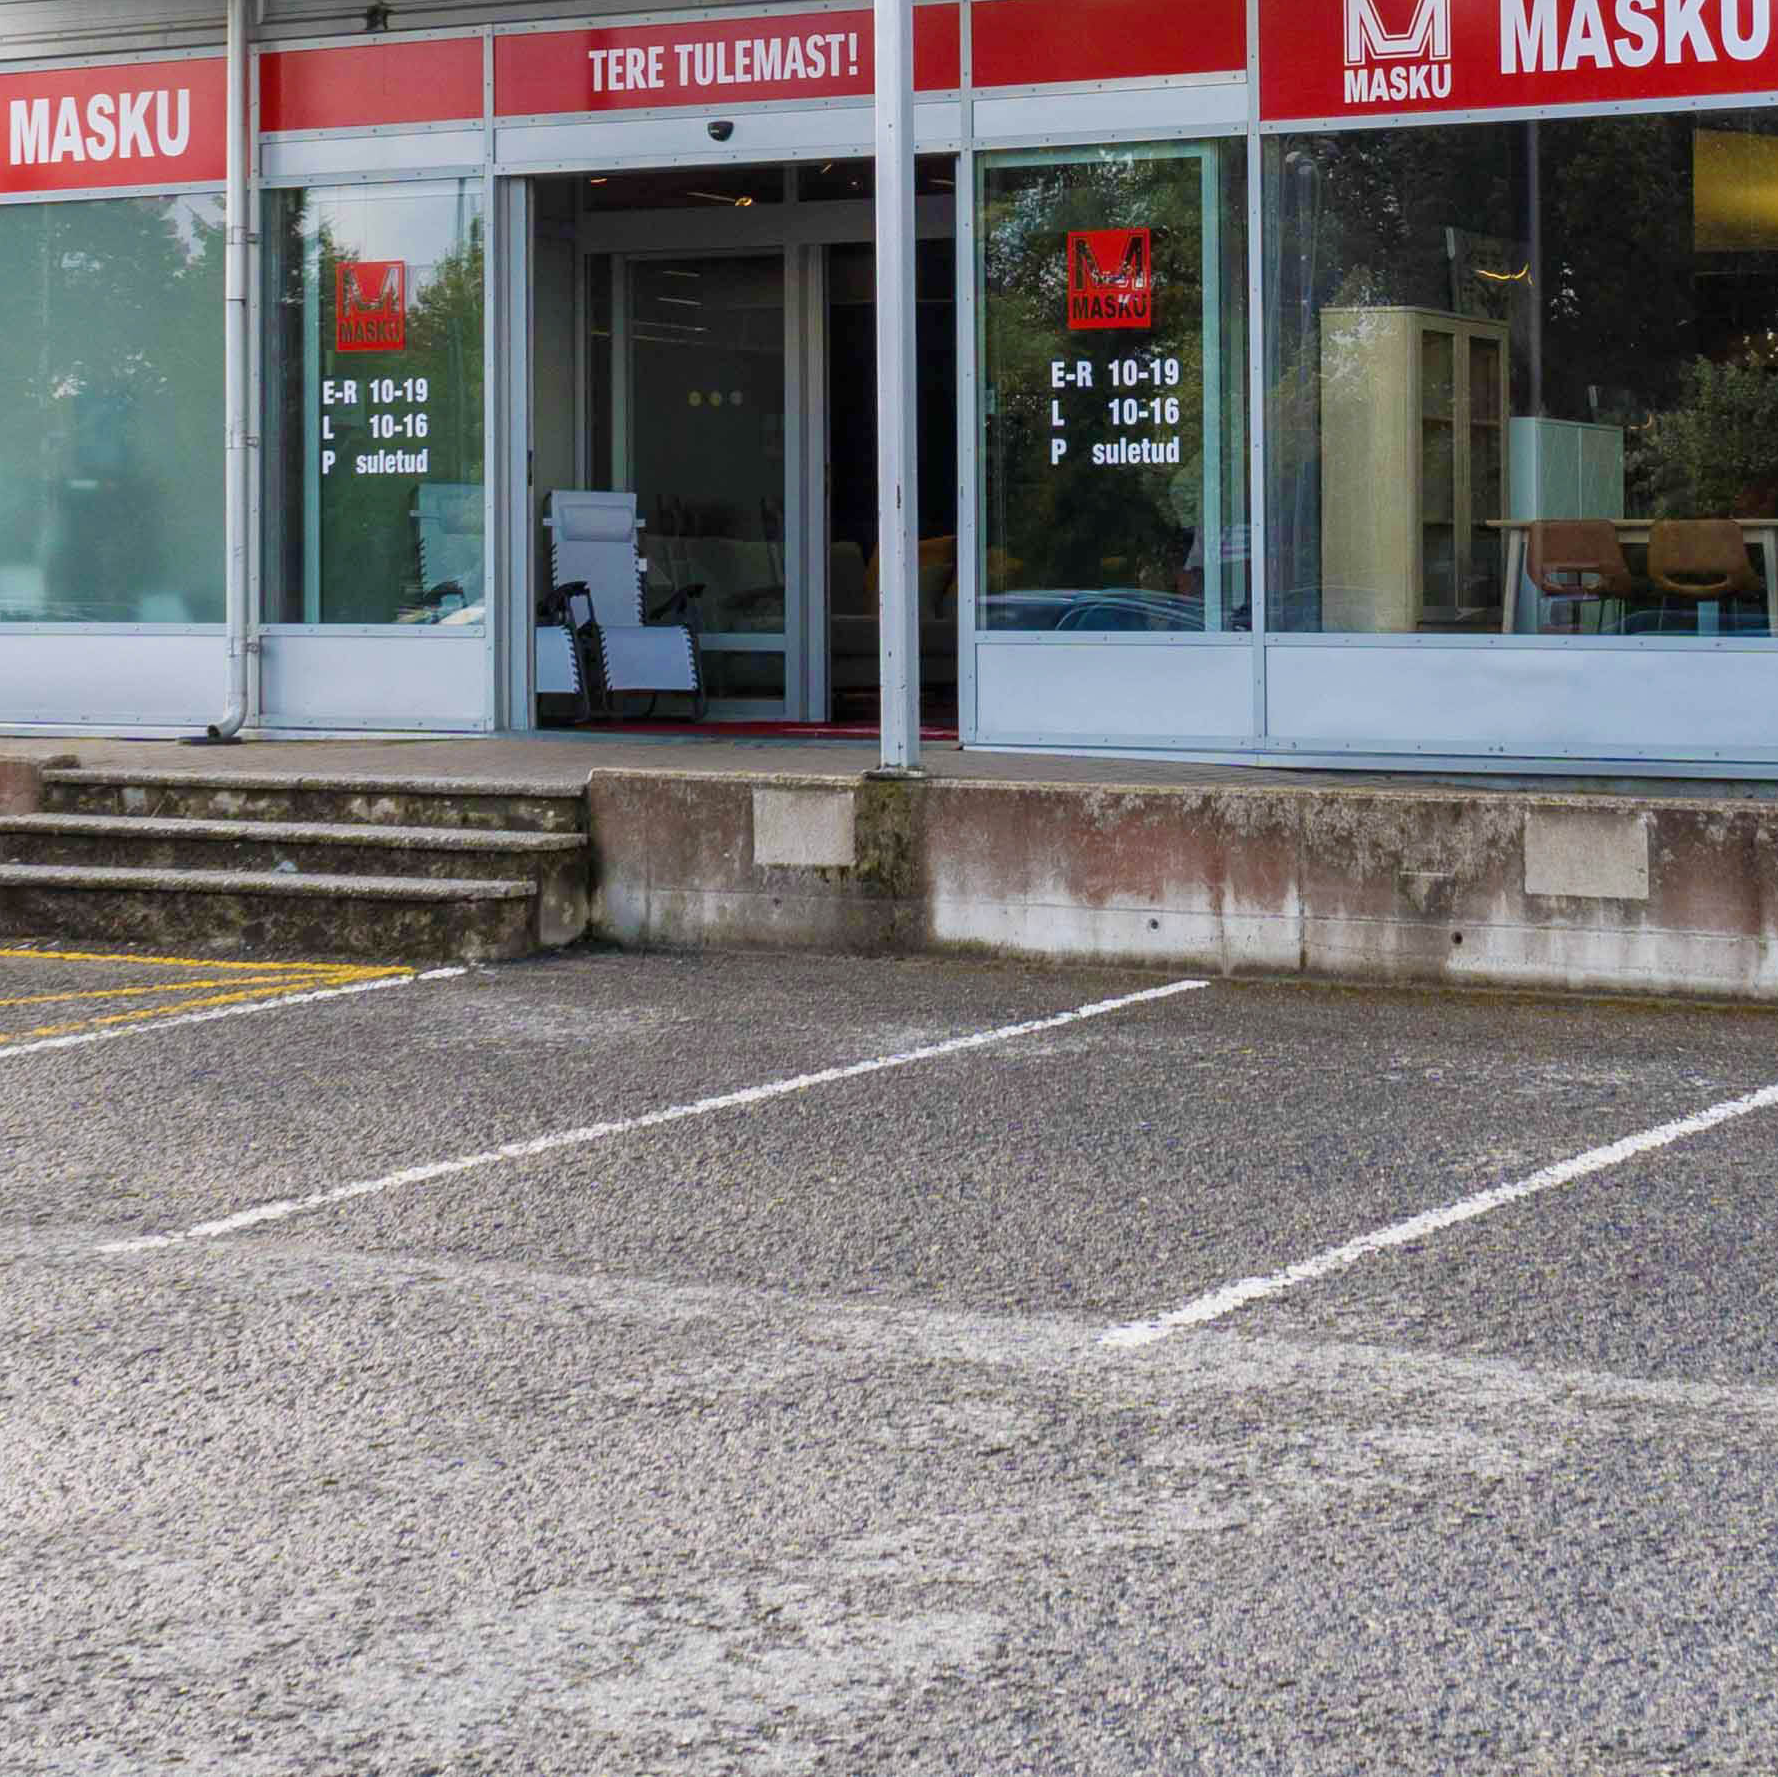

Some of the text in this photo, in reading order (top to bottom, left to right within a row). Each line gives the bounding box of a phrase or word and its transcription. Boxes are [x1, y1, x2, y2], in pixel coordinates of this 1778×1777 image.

[588, 32, 858, 92] TERE TULEMAST!
[1344, 62, 1452, 104] MASKU
[9, 88, 190, 166] MASKU
[1073, 292, 1147, 320] MASKU
[339, 316, 401, 343] MASKU
[1051, 357, 1180, 388] E-R 10-19
[323, 377, 429, 405] E-R 10-19
[323, 412, 429, 440] L 10-16
[1051, 396, 1180, 427] L 10-16
[322, 447, 429, 475] P suletud
[1051, 435, 1180, 465] P suletud
